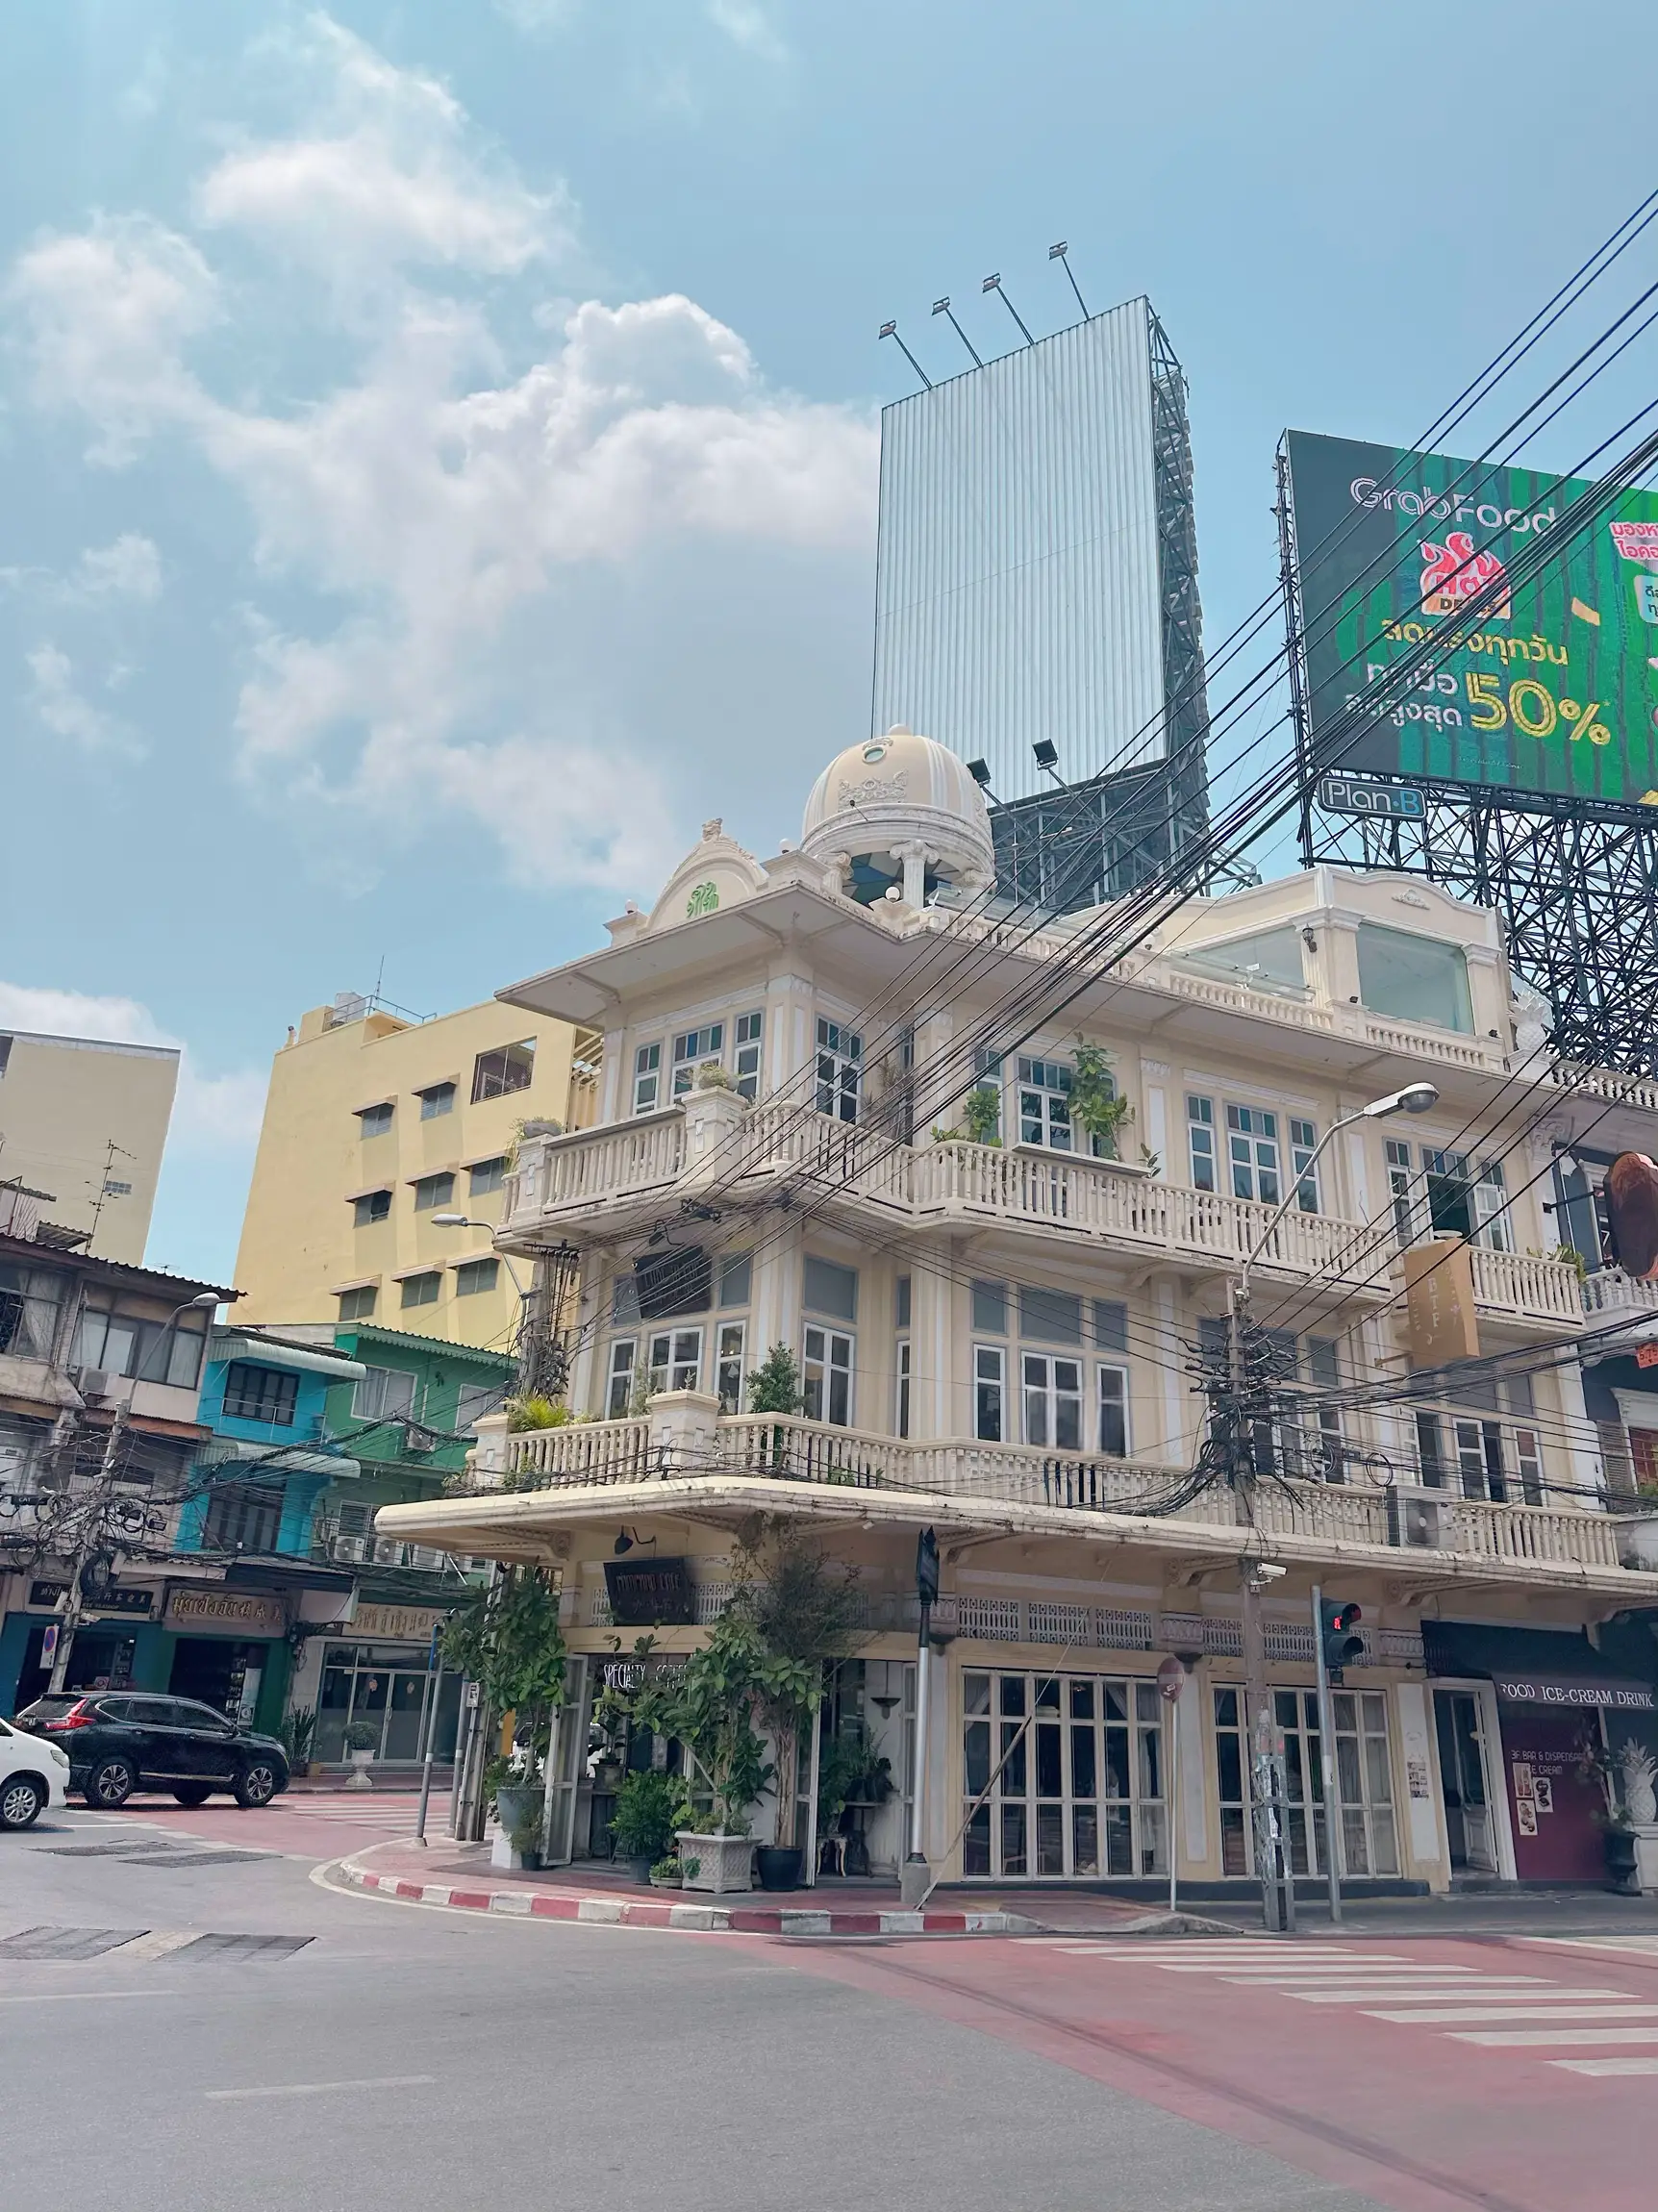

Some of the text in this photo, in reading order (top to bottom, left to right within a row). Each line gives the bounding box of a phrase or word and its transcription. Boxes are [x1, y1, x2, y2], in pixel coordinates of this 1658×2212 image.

[1350, 477, 1556, 537] GrabFood
[1466, 671, 1612, 746] 50%
[1541, 1686, 1614, 1704] ICE-CREAM
[1617, 1691, 1655, 1707] DRINK
[1522, 1750, 1537, 1761] BAR
[1538, 1765, 1563, 1775] CREAM
